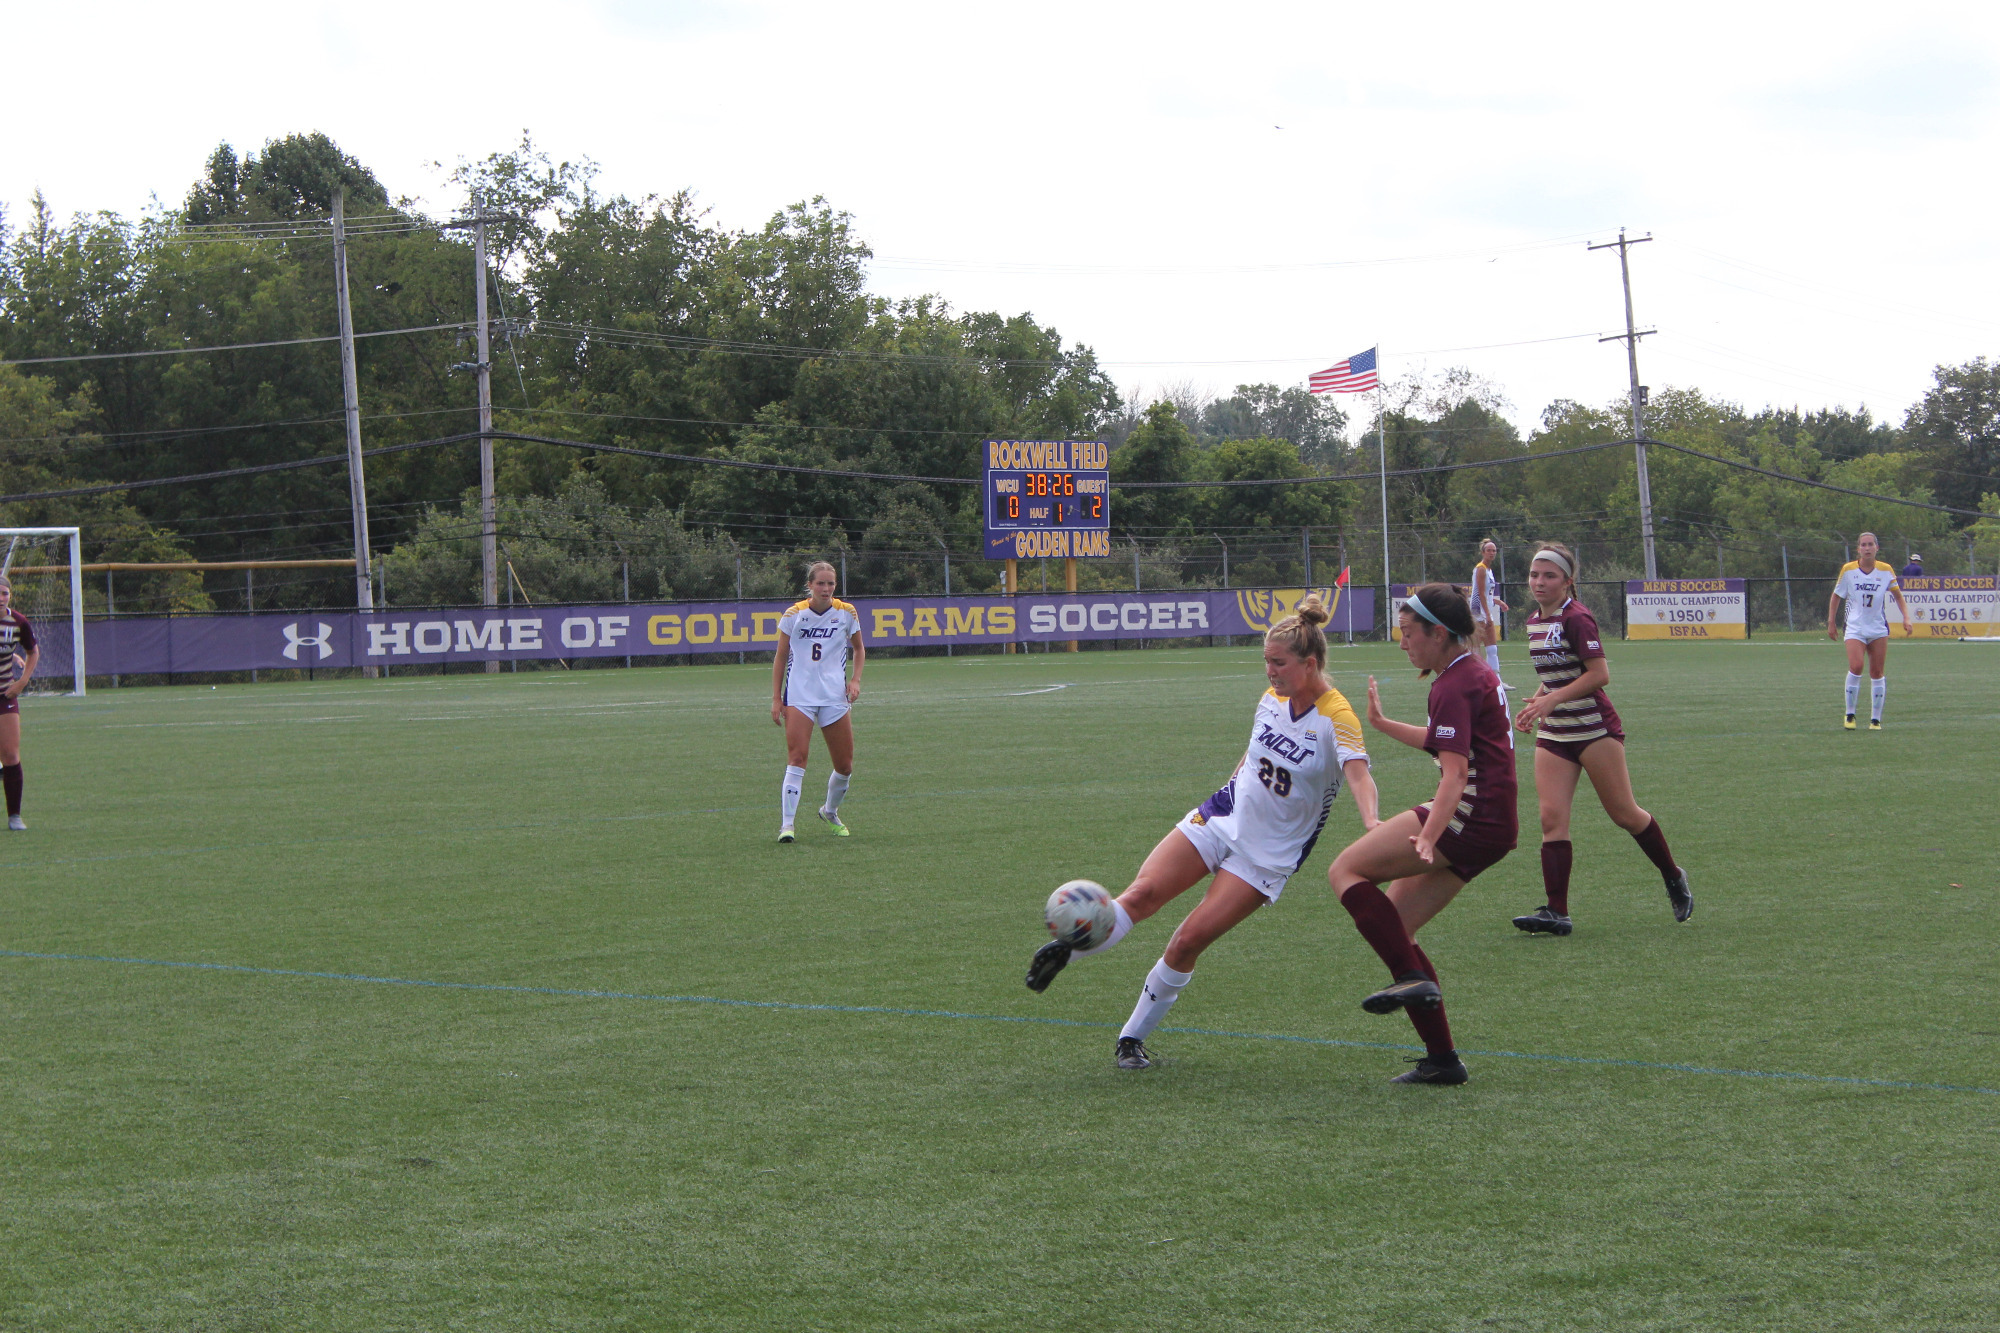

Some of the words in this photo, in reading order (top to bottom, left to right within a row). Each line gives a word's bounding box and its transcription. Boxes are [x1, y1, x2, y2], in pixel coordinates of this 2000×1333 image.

[989, 441, 1067, 469] ROCKWELL
[1071, 442, 1108, 469] FIELD
[996, 479, 1019, 493] WCU
[1026, 473, 1074, 496] 38:26
[1076, 479, 1106, 493] GUEST
[1009, 495, 1019, 518] 0
[1029, 507, 1049, 519] HALF
[1092, 495, 1102, 518] 2
[1015, 530, 1069, 558] GOLDEN
[1073, 531, 1110, 557] RAMS
[1643, 581, 1677, 592] MEN'S
[1680, 580, 1727, 592] SOCCER
[1855, 583, 1881, 592] WCU
[1903, 578, 1940, 590] MEN'S
[1944, 577, 1994, 589] SOCCER
[1631, 597, 1678, 606] NATIONAL
[1681, 596, 1741, 605] CHAMPIONS
[1889, 594, 1941, 603] NTIONAL
[1669, 610, 1704, 622] 1950
[1929, 608, 1967, 621] 1961
[367, 618, 543, 656] HOME
[560, 615, 630, 649] OF
[647, 612, 782, 646] GOLD
[871, 605, 1016, 638] RAMS
[1029, 600, 1209, 633] SOCCER
[1669, 626, 1708, 637] ISFAA
[1930, 625, 1970, 636] NCAA
[811, 642, 823, 662] 6
[1255, 723, 1315, 766] WCU
[1258, 756, 1293, 798] 29
